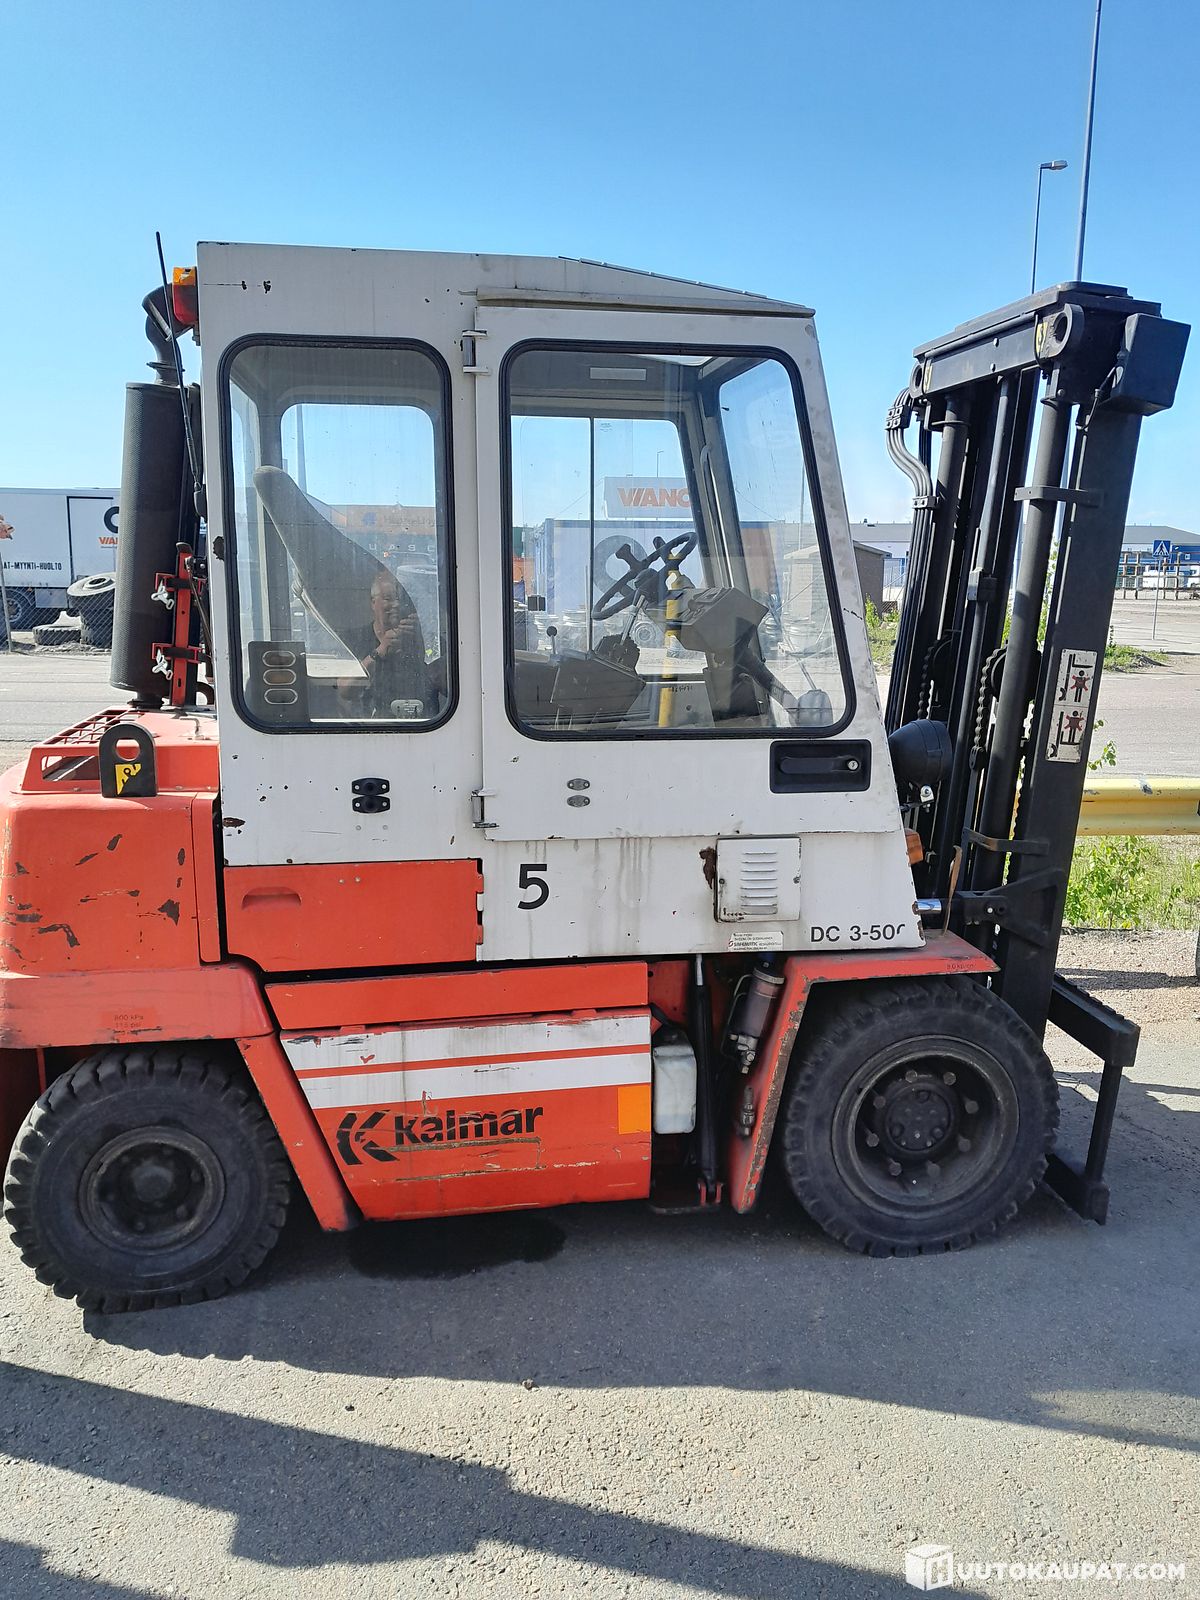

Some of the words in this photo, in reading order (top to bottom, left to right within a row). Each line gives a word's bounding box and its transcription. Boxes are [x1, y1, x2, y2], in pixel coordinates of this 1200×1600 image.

[518, 863, 550, 910] 5
[811, 926, 840, 942] DC
[394, 1106, 544, 1146] kalmar
